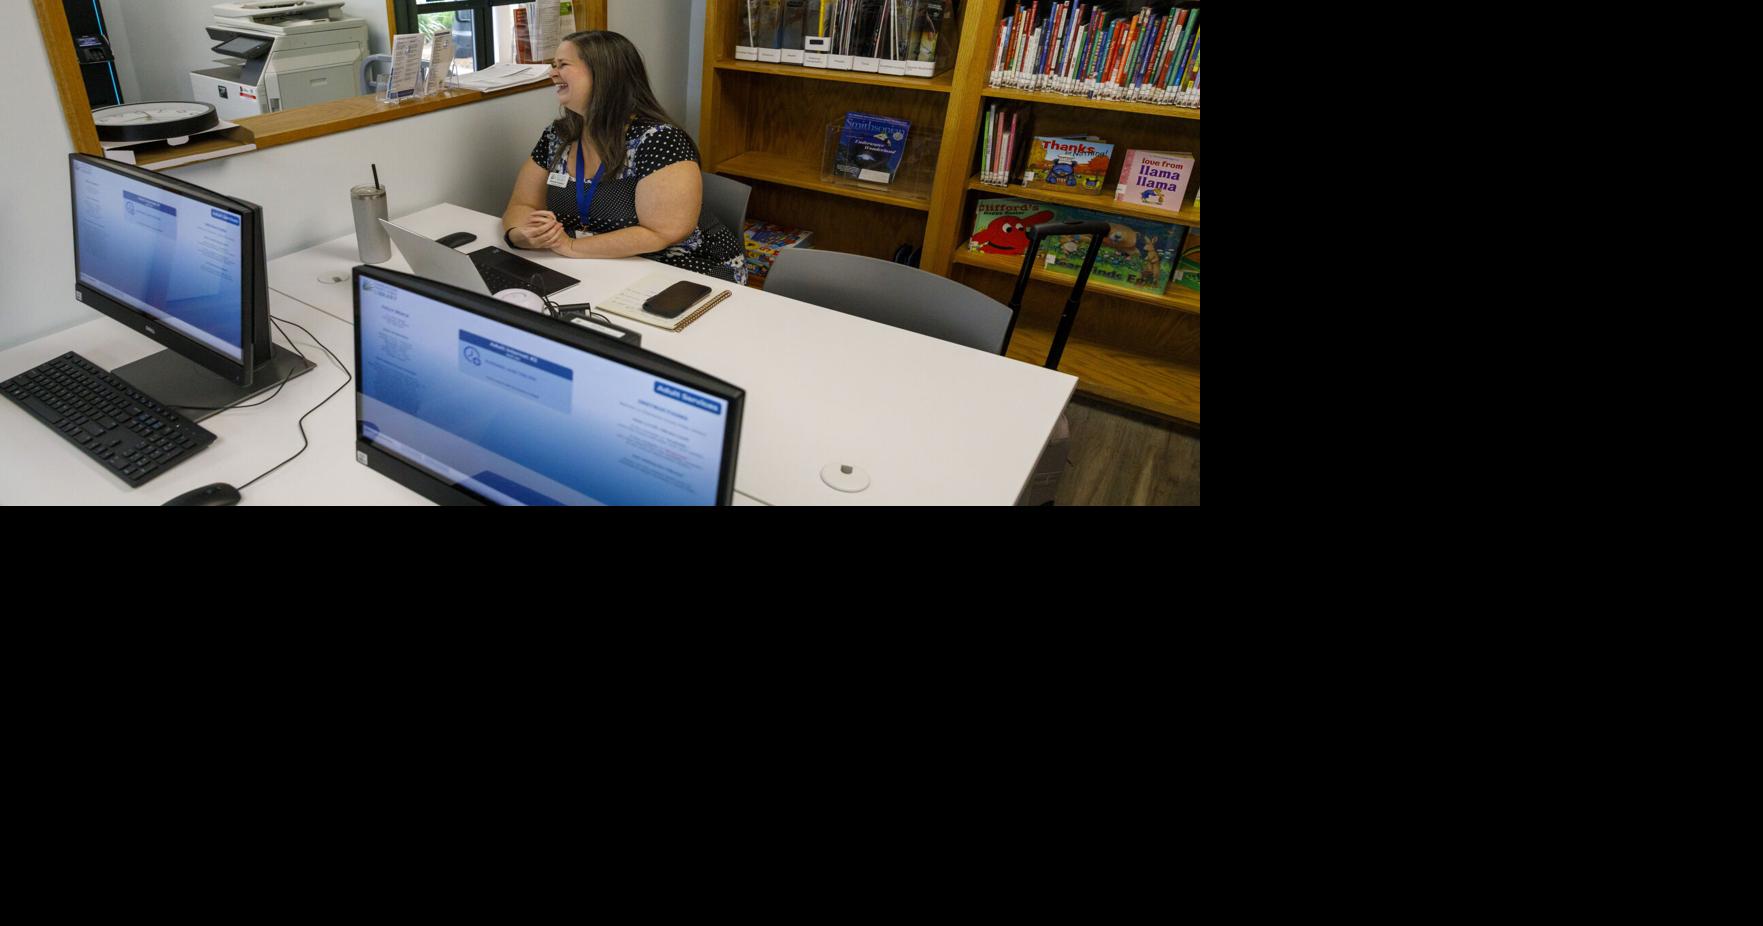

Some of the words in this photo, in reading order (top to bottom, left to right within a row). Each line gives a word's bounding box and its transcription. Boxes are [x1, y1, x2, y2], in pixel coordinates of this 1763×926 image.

[846, 119, 905, 135] Smithsonian
[1042, 140, 1096, 154] Thanks
[1141, 158, 1160, 167] love
[1161, 161, 1184, 170] from
[1140, 165, 1180, 181] llama
[1136, 176, 1177, 192] llama
[656, 384, 680, 398] Adult
[681, 392, 719, 411] Services
